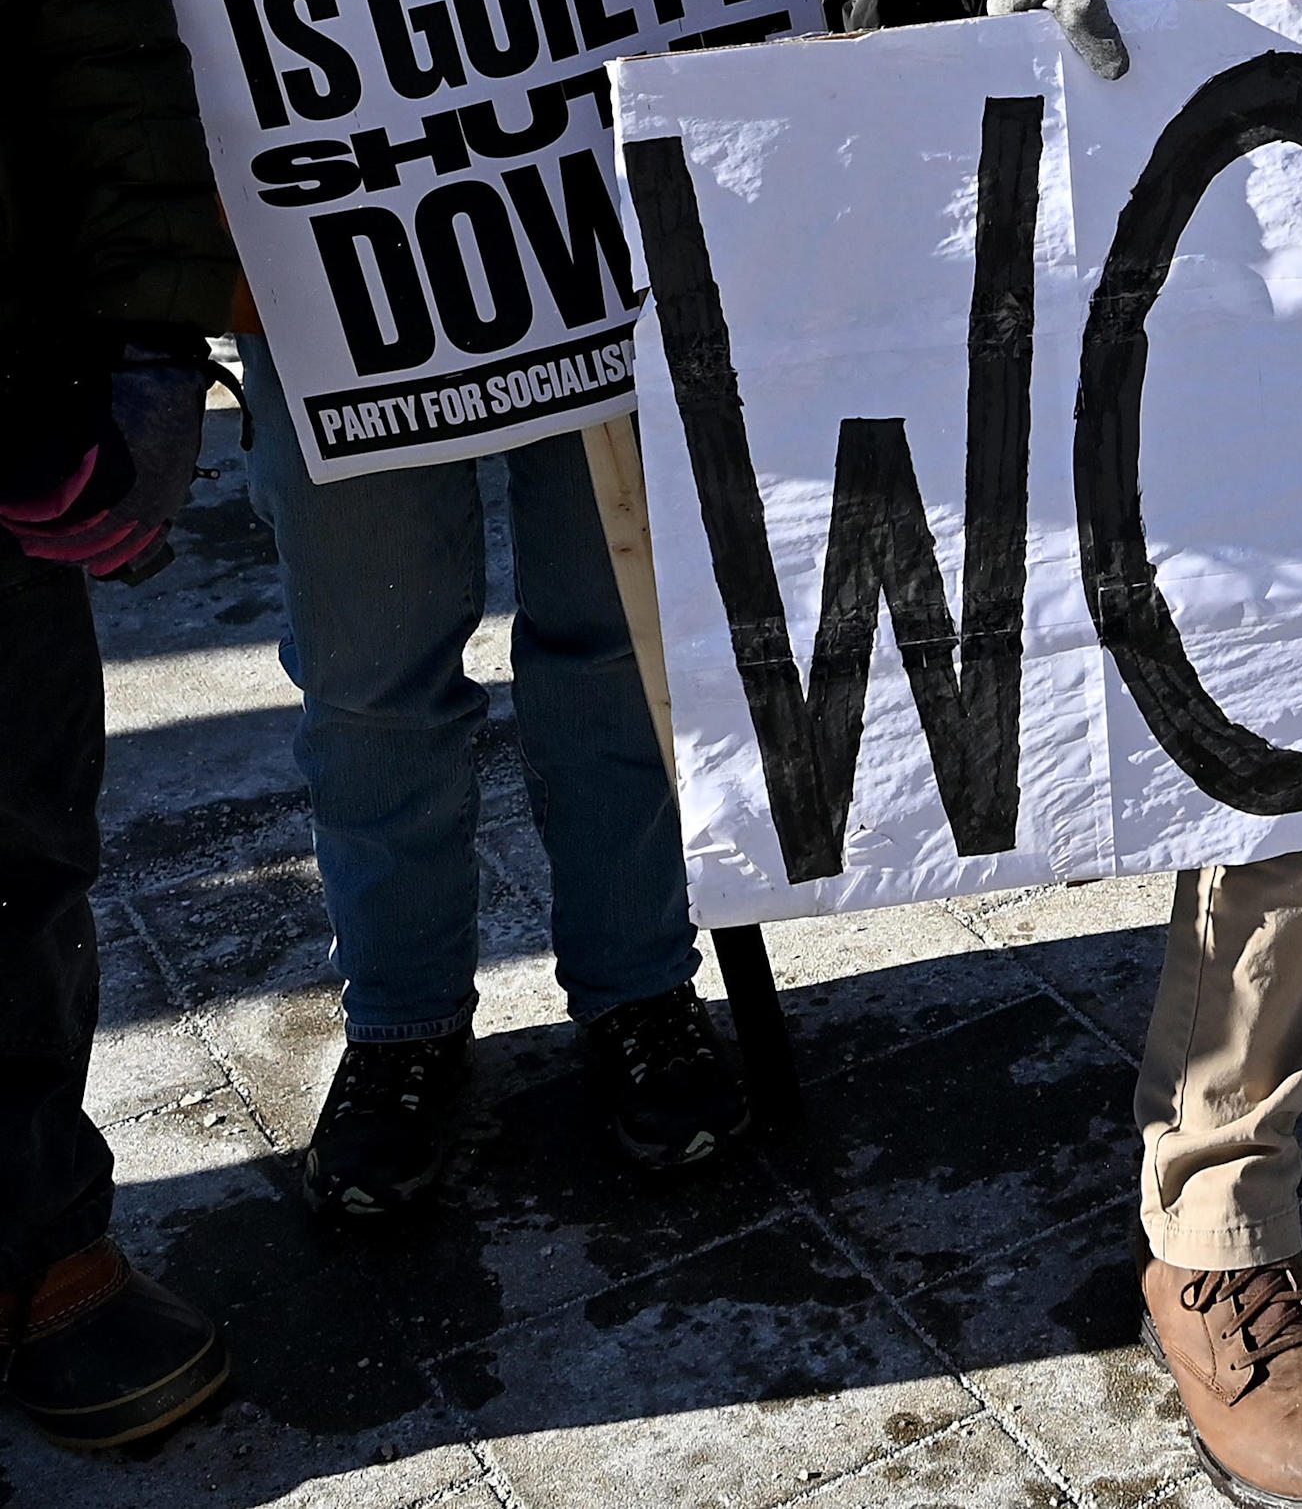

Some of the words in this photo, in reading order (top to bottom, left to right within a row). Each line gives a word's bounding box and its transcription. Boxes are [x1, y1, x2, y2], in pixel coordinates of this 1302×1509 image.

[309, 148, 644, 377] DOW
[318, 395, 419, 445] PARTY
[421, 383, 487, 428] FOR
